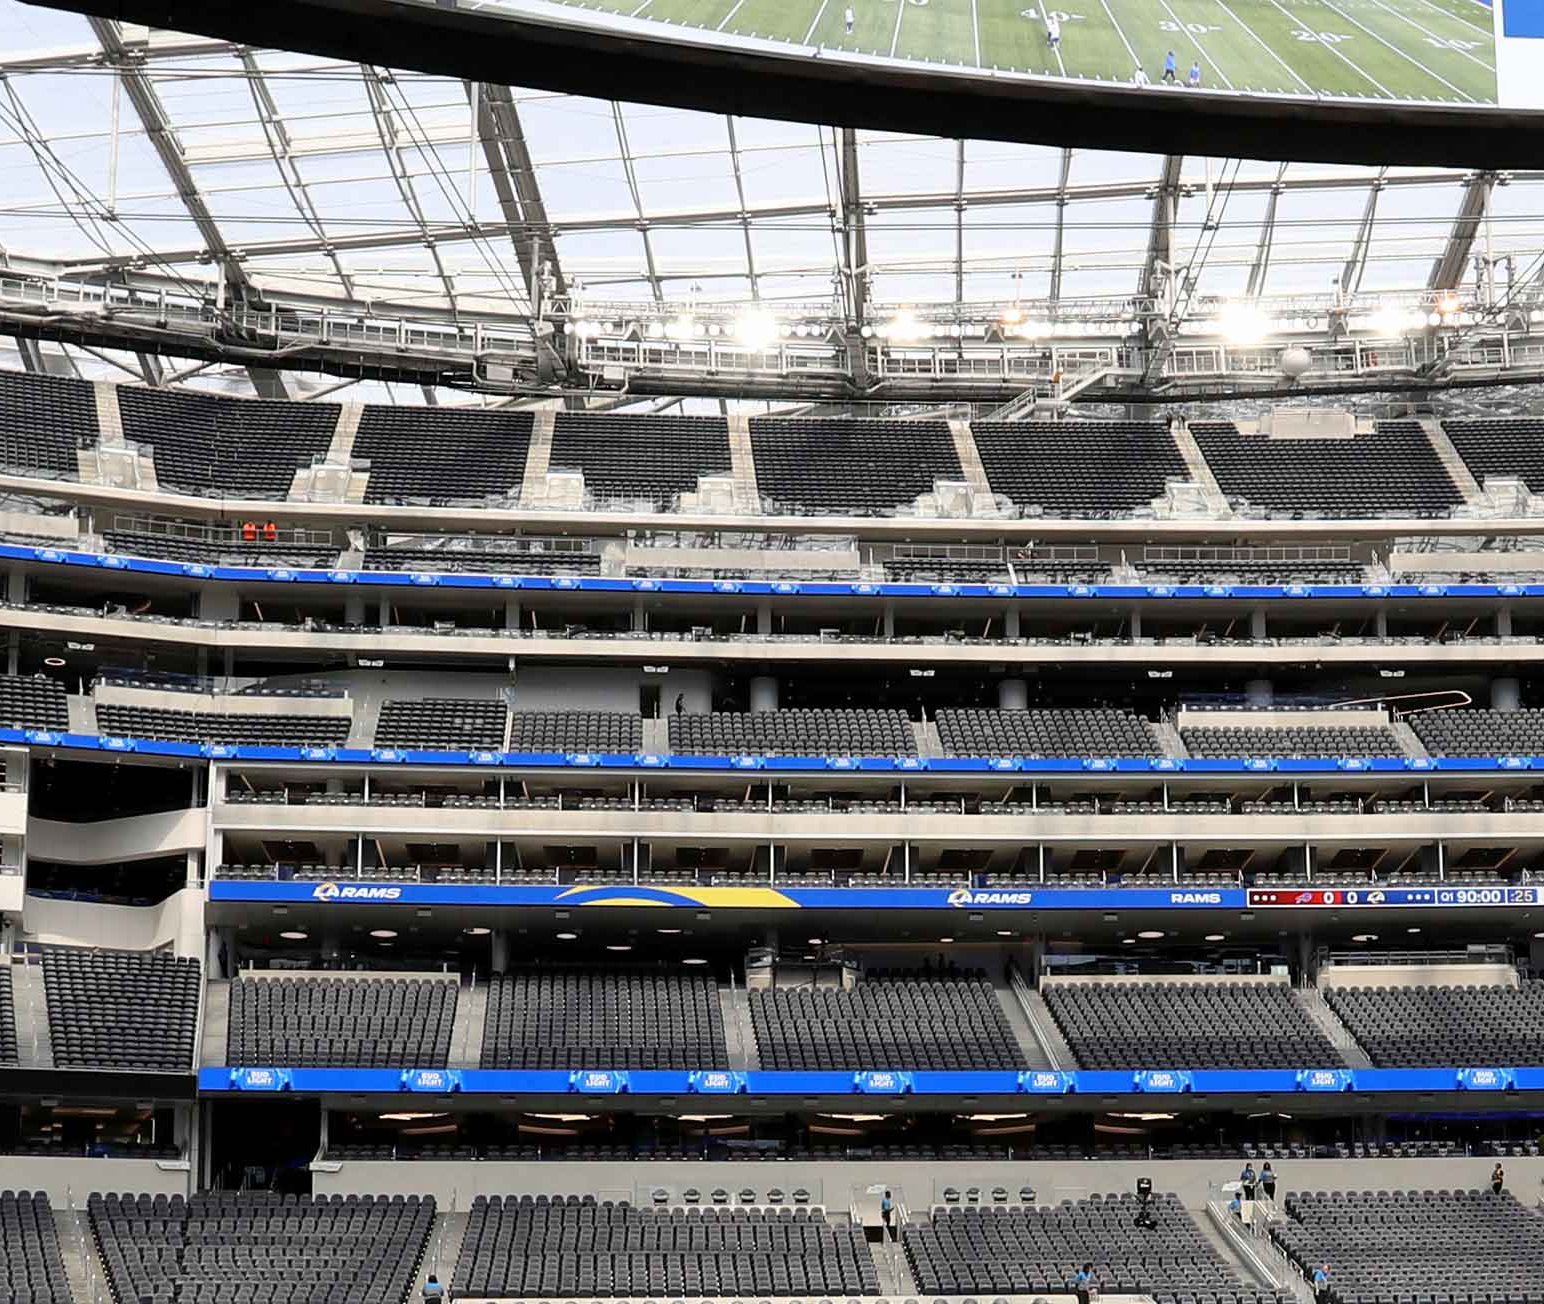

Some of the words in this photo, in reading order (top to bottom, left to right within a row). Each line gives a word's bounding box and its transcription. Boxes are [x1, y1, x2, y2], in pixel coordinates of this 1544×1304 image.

[342, 887, 401, 900] RAMS
[973, 893, 1031, 905] RAMS
[1171, 893, 1221, 904] RAMS
[1324, 891, 1335, 905] 0
[1347, 890, 1358, 905] 0
[1457, 890, 1501, 904] 90:00
